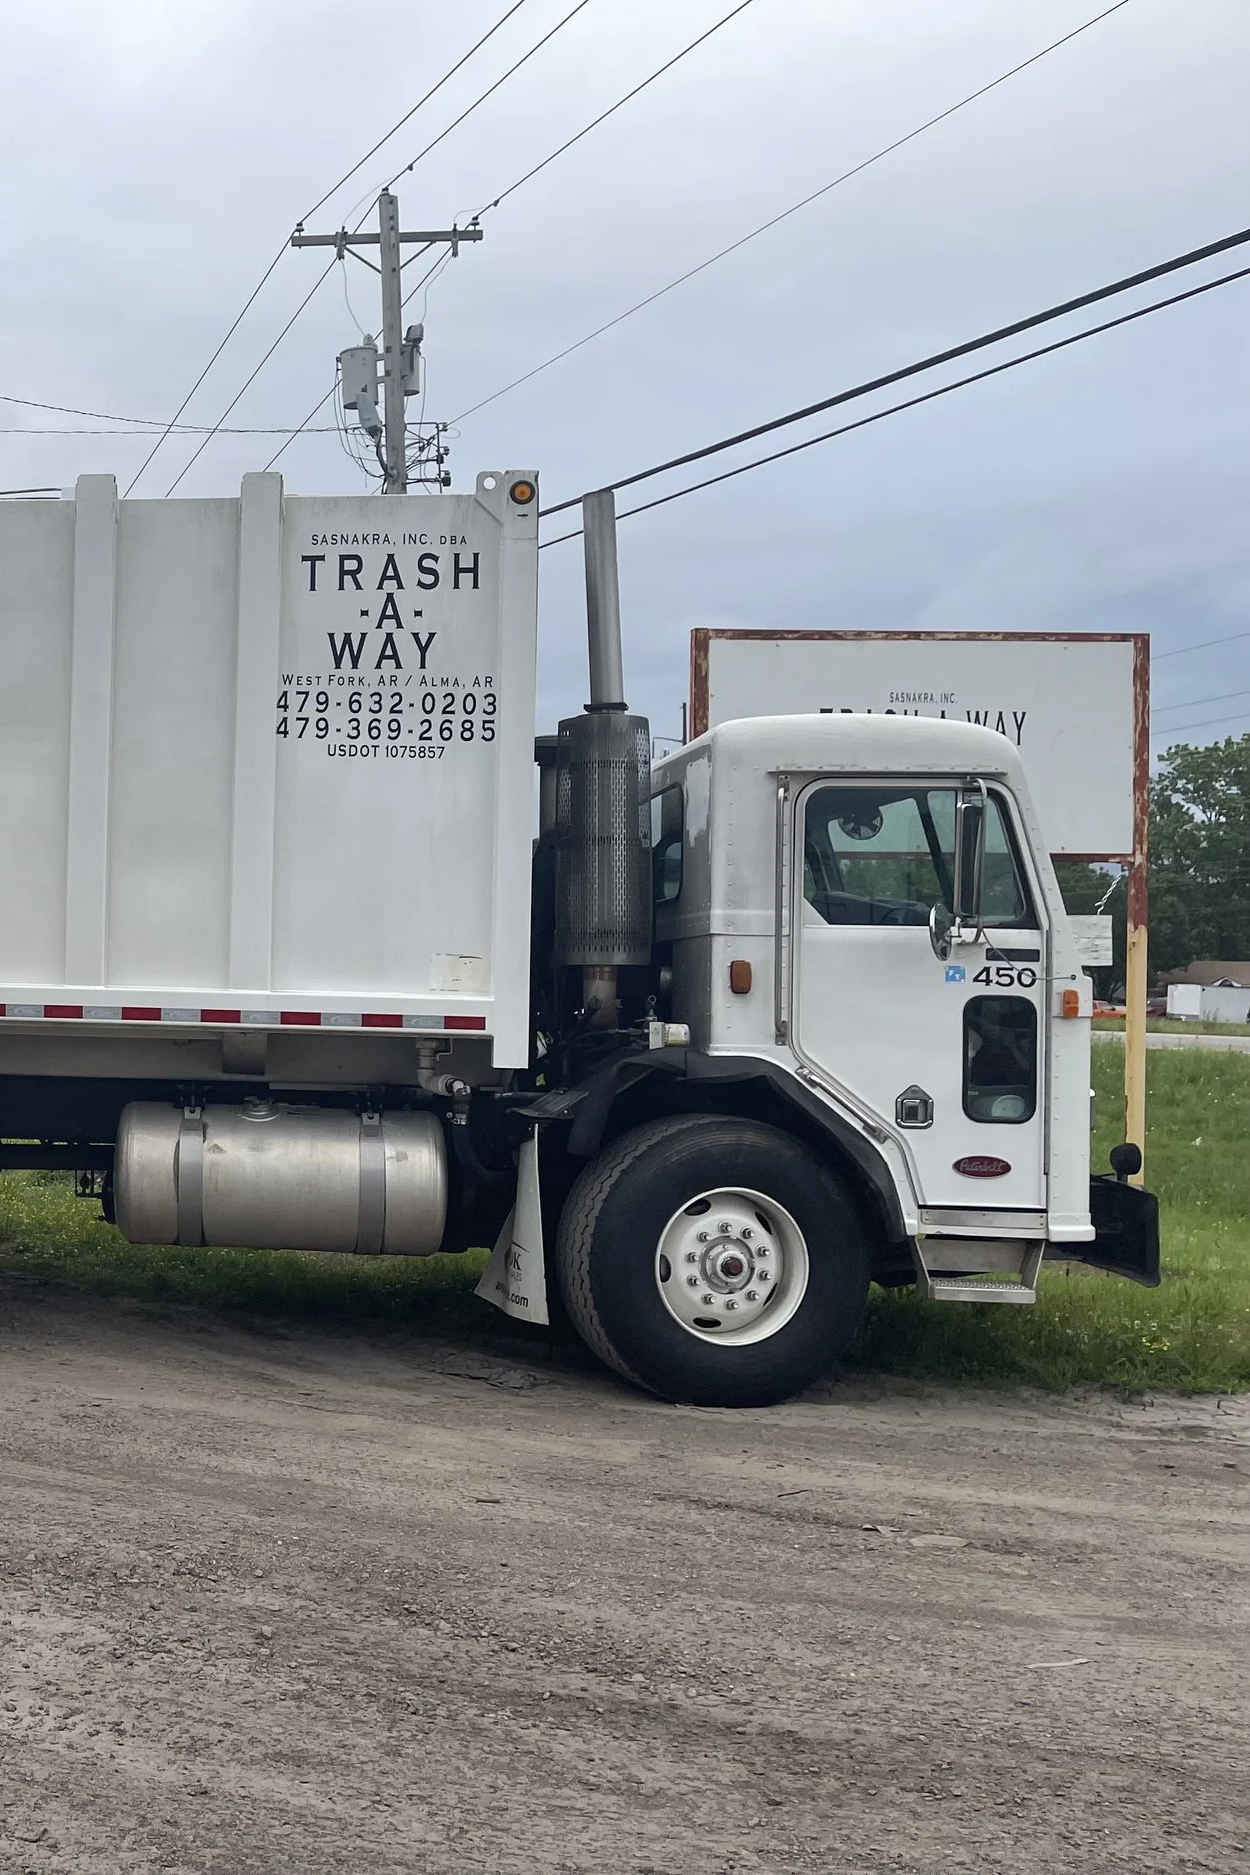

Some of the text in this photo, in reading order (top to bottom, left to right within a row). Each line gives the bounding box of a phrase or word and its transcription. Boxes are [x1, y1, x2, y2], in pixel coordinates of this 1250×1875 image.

[311, 533, 467, 546] SASNAKRA, INC. DBA
[301, 552, 480, 591] TRASH
[327, 632, 437, 669] WAY
[377, 675, 398, 687] AR
[405, 675, 412, 686] /
[472, 676, 493, 687] AR
[276, 690, 497, 715] 479-632-0203
[889, 692, 958, 704] SASNAKRA, INC.
[276, 716, 496, 742] 479-369-2685
[328, 744, 445, 759] USDOT 1075857
[972, 966, 1037, 988] 450
